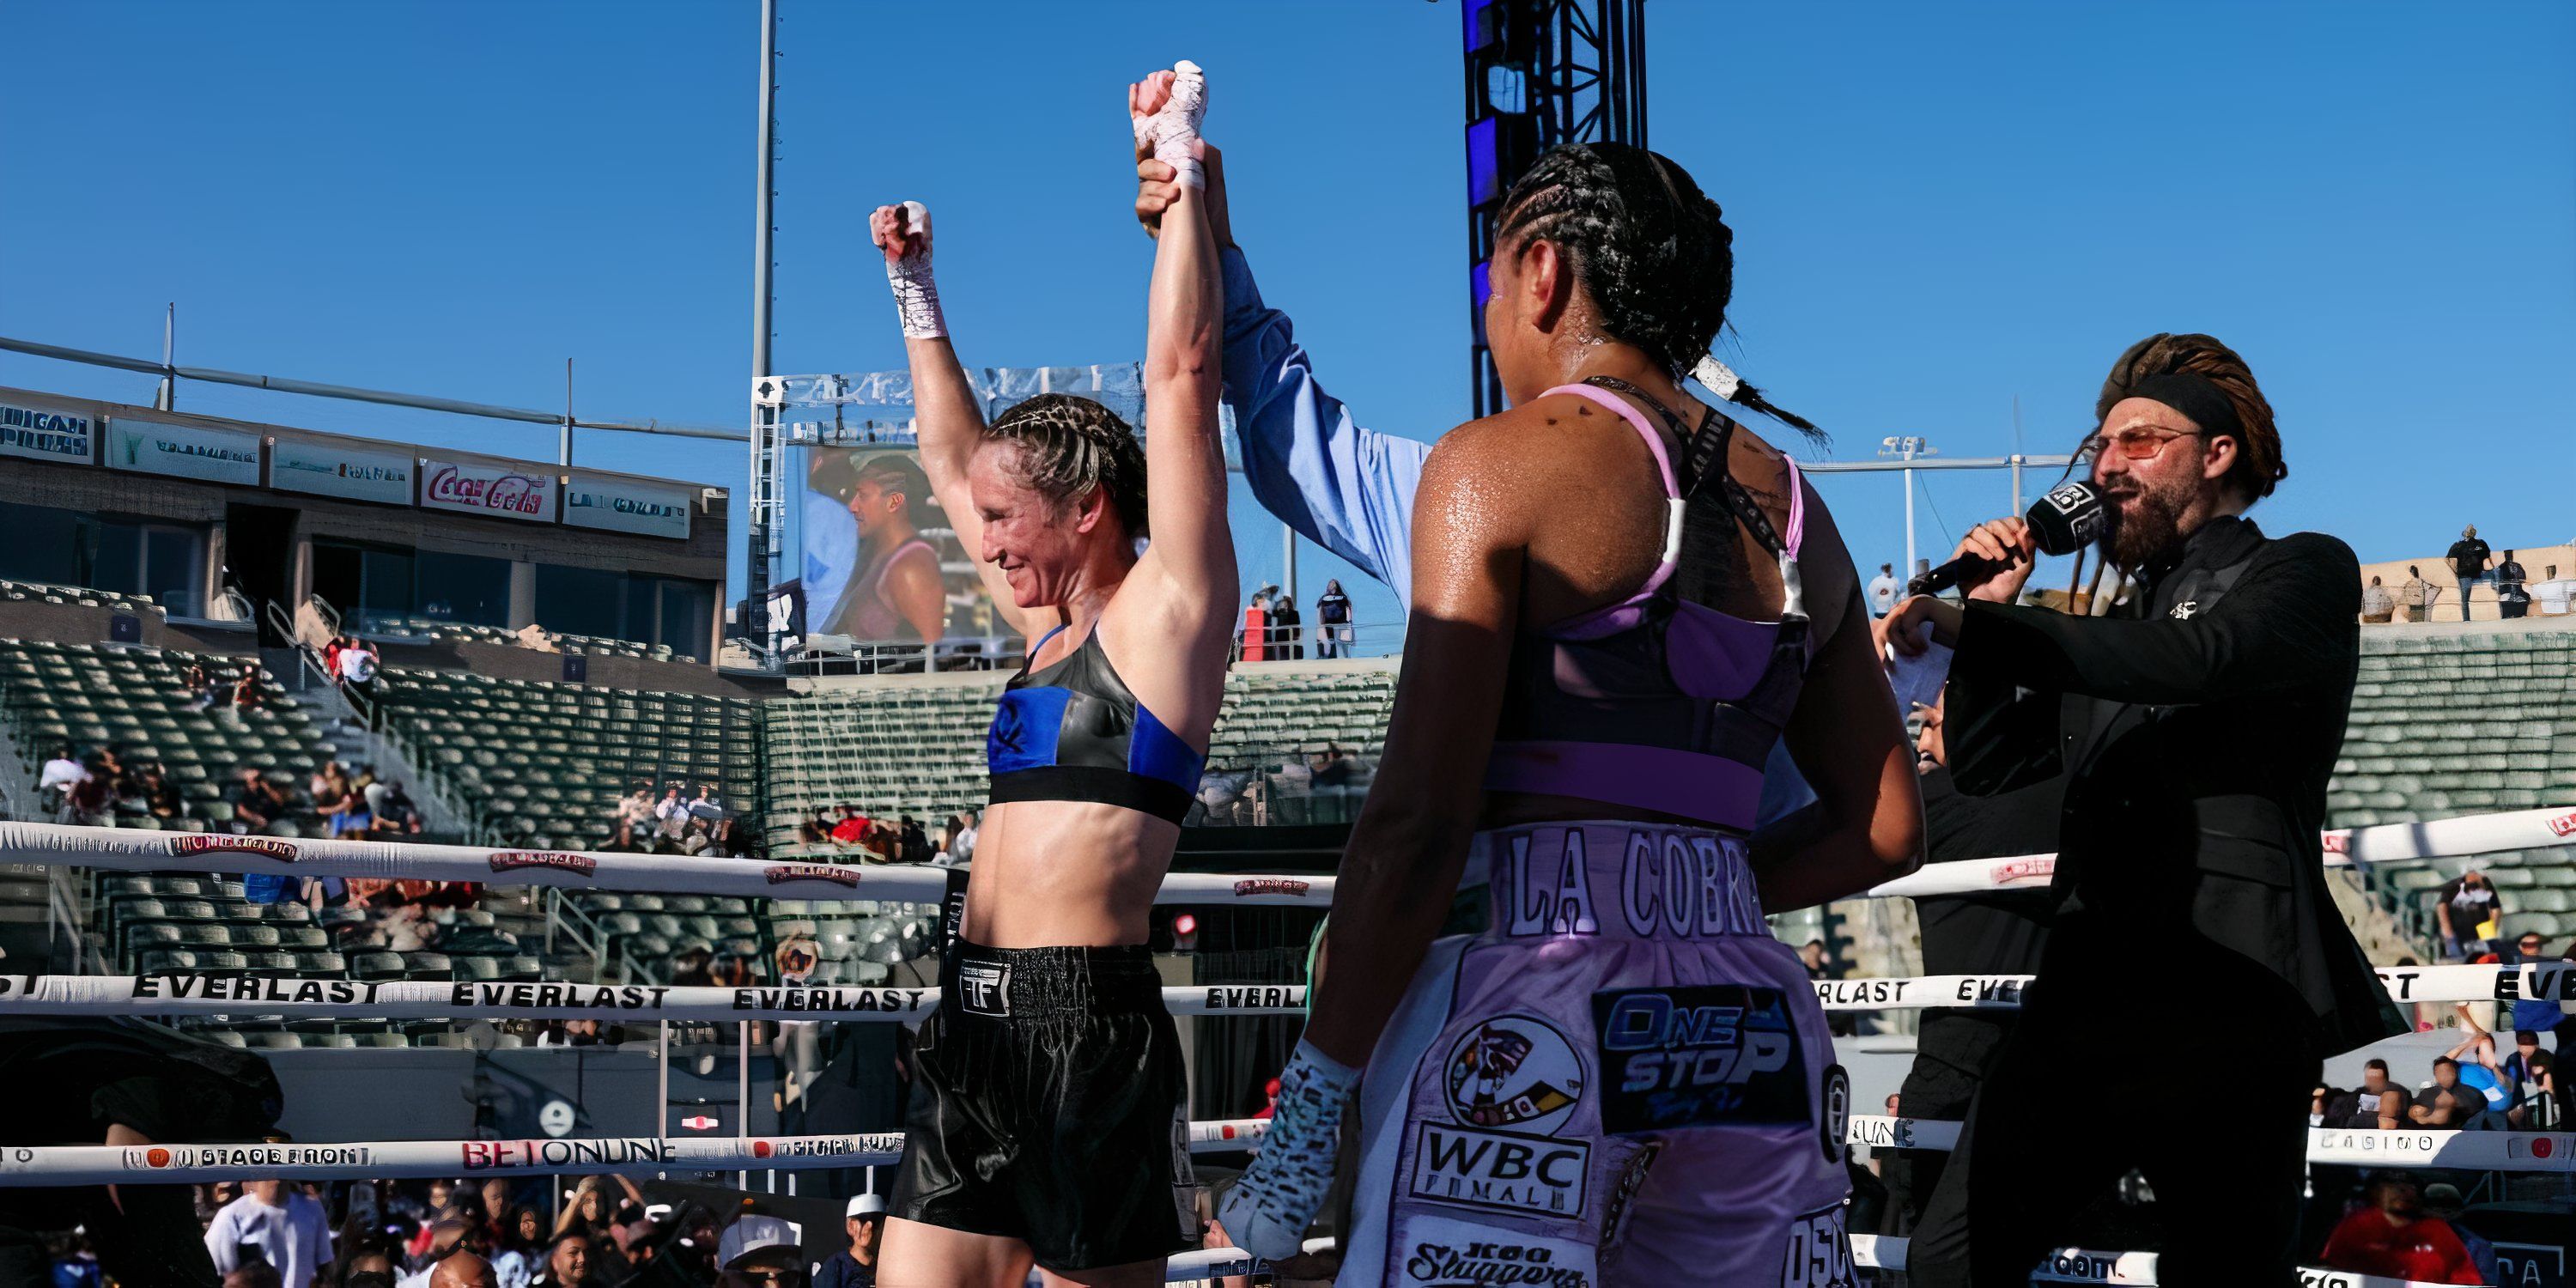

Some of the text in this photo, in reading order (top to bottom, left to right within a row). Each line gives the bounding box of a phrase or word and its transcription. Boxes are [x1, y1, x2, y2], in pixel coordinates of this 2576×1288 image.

[1507, 827, 1601, 937] LA
[132, 974, 378, 1004] EVERLAST
[451, 982, 925, 1012] EVERLAST EVERLAST
[1206, 987, 1307, 1008] EVERL
[1603, 993, 1746, 1052] ONE
[1621, 1030, 1791, 1094] STOP
[1429, 1132, 1580, 1188] WBC
